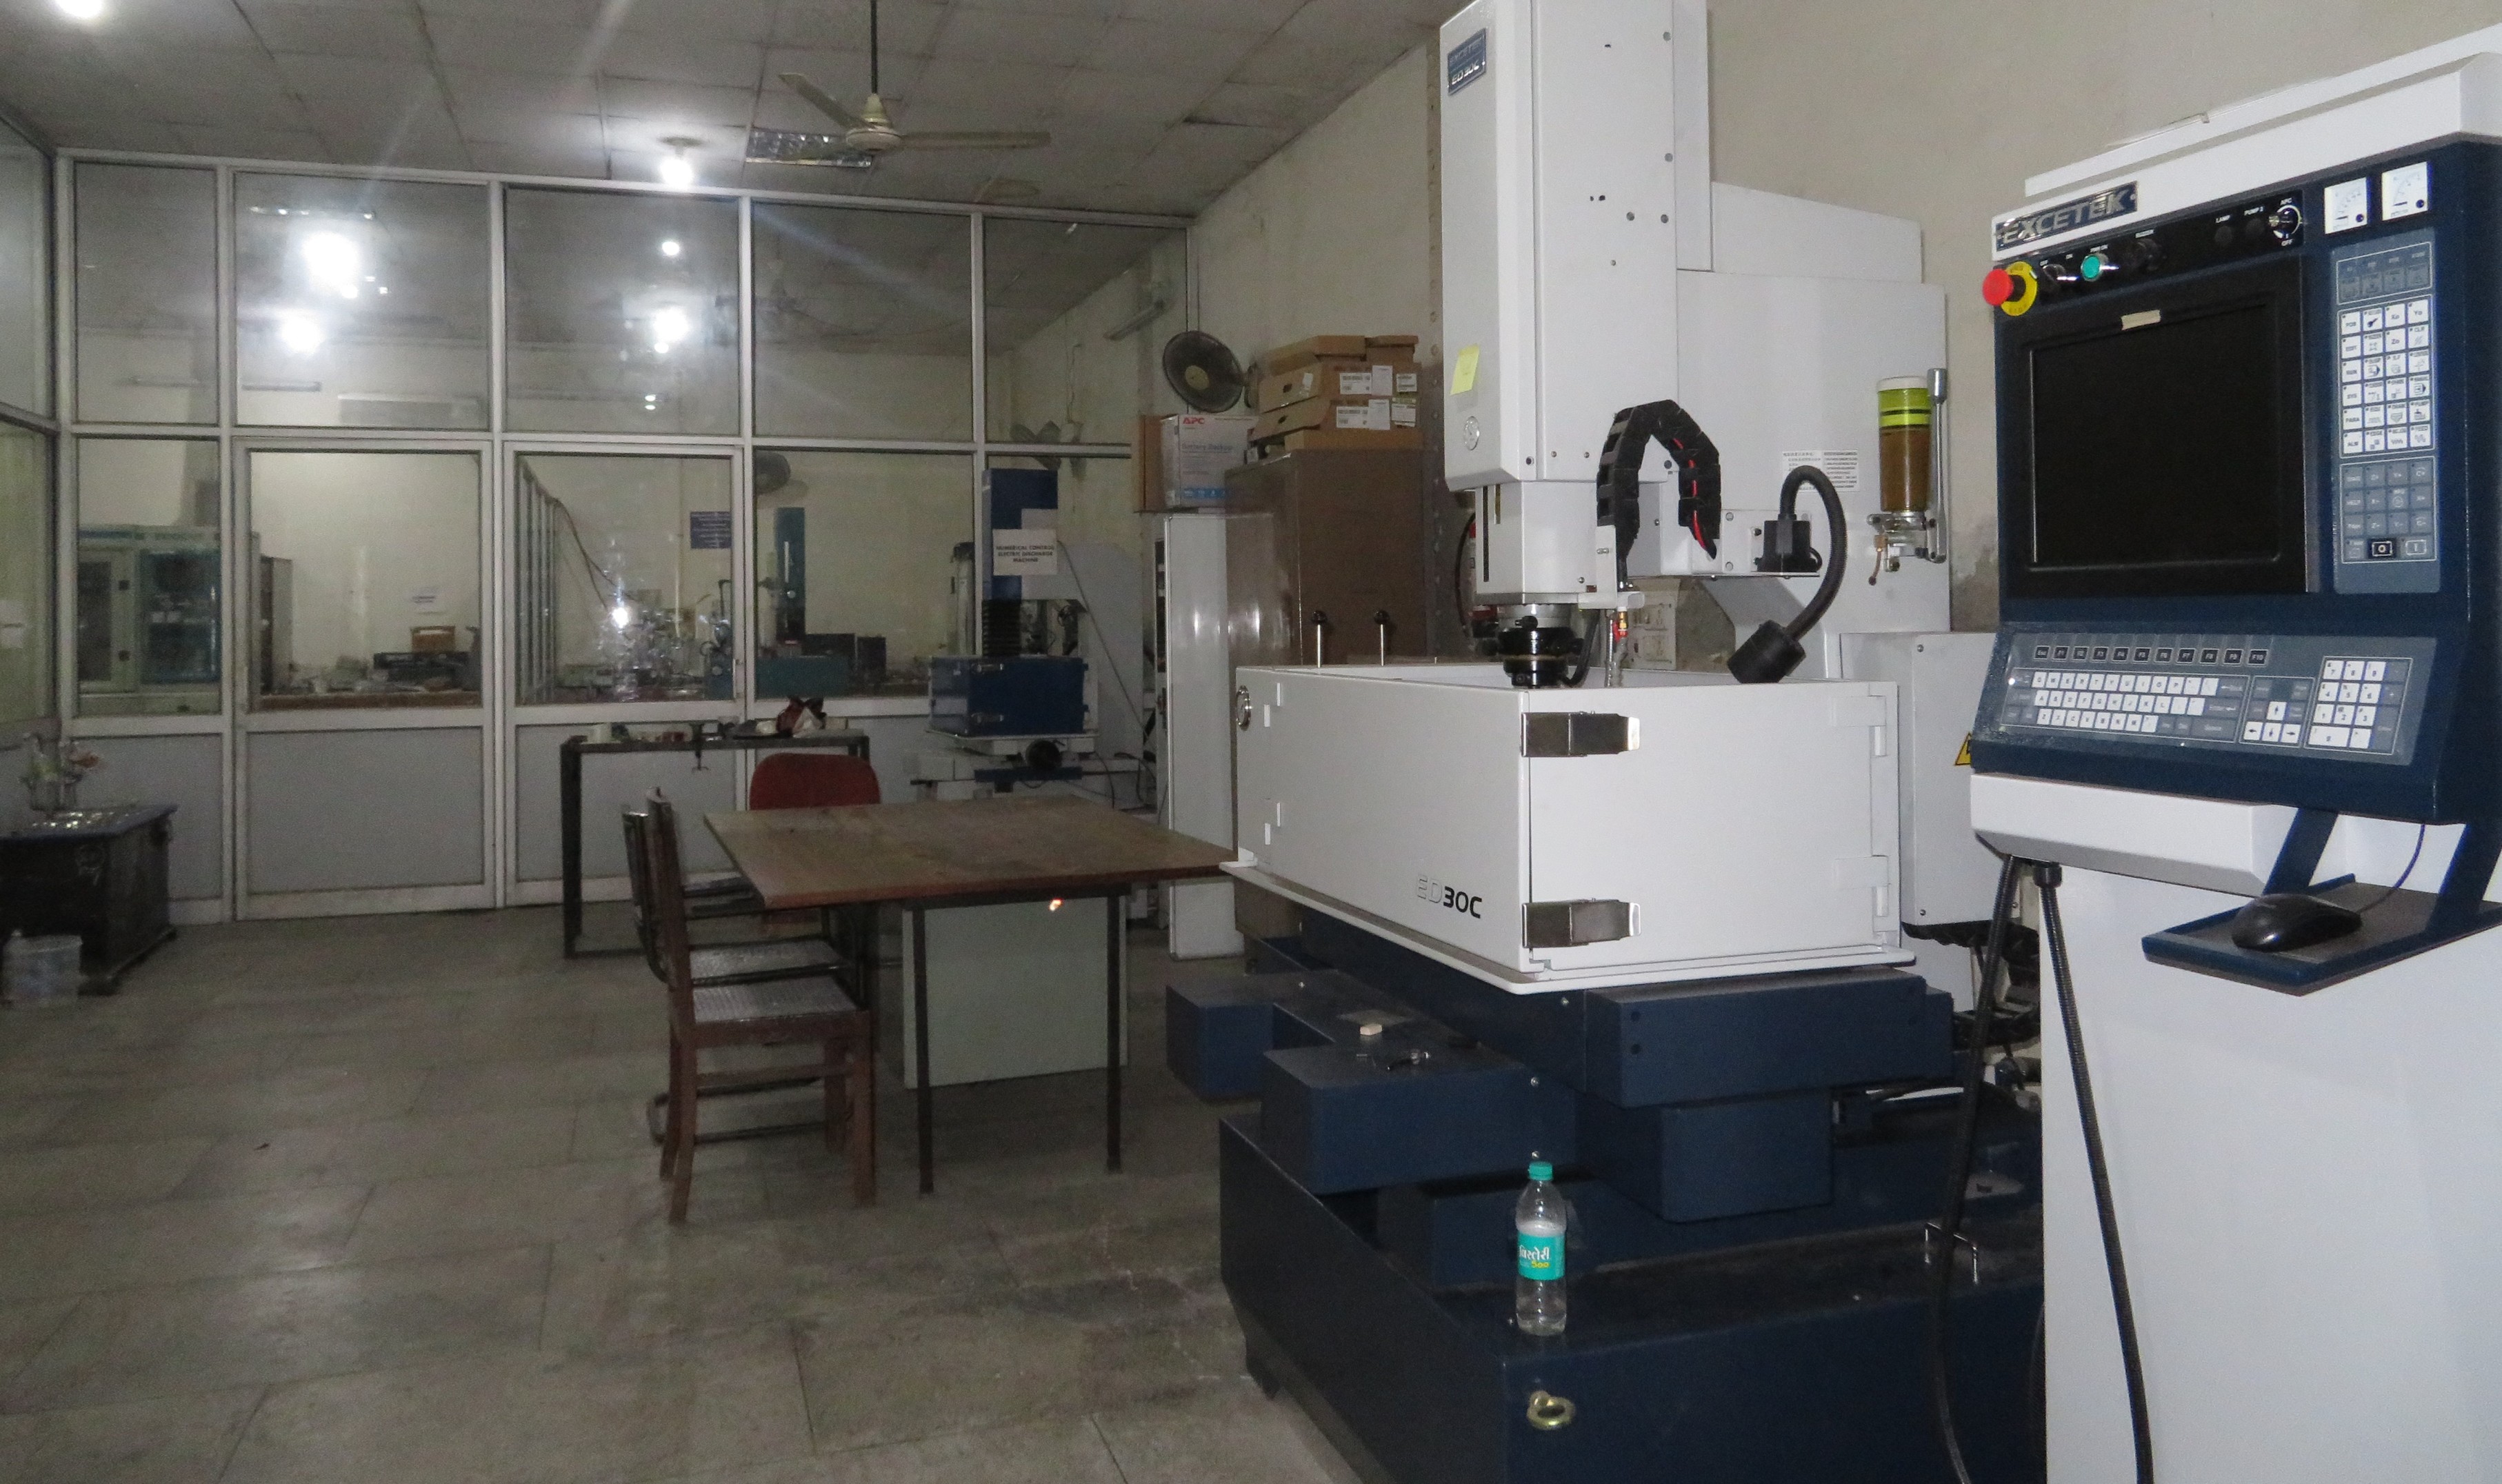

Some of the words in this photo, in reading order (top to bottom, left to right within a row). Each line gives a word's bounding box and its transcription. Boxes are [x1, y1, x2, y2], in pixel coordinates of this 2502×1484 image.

[2003, 189, 2128, 243] EXCETEK
[2281, 239, 2294, 247] OFF
[1183, 417, 1205, 425] APC
[1416, 874, 1483, 919] ED30C
